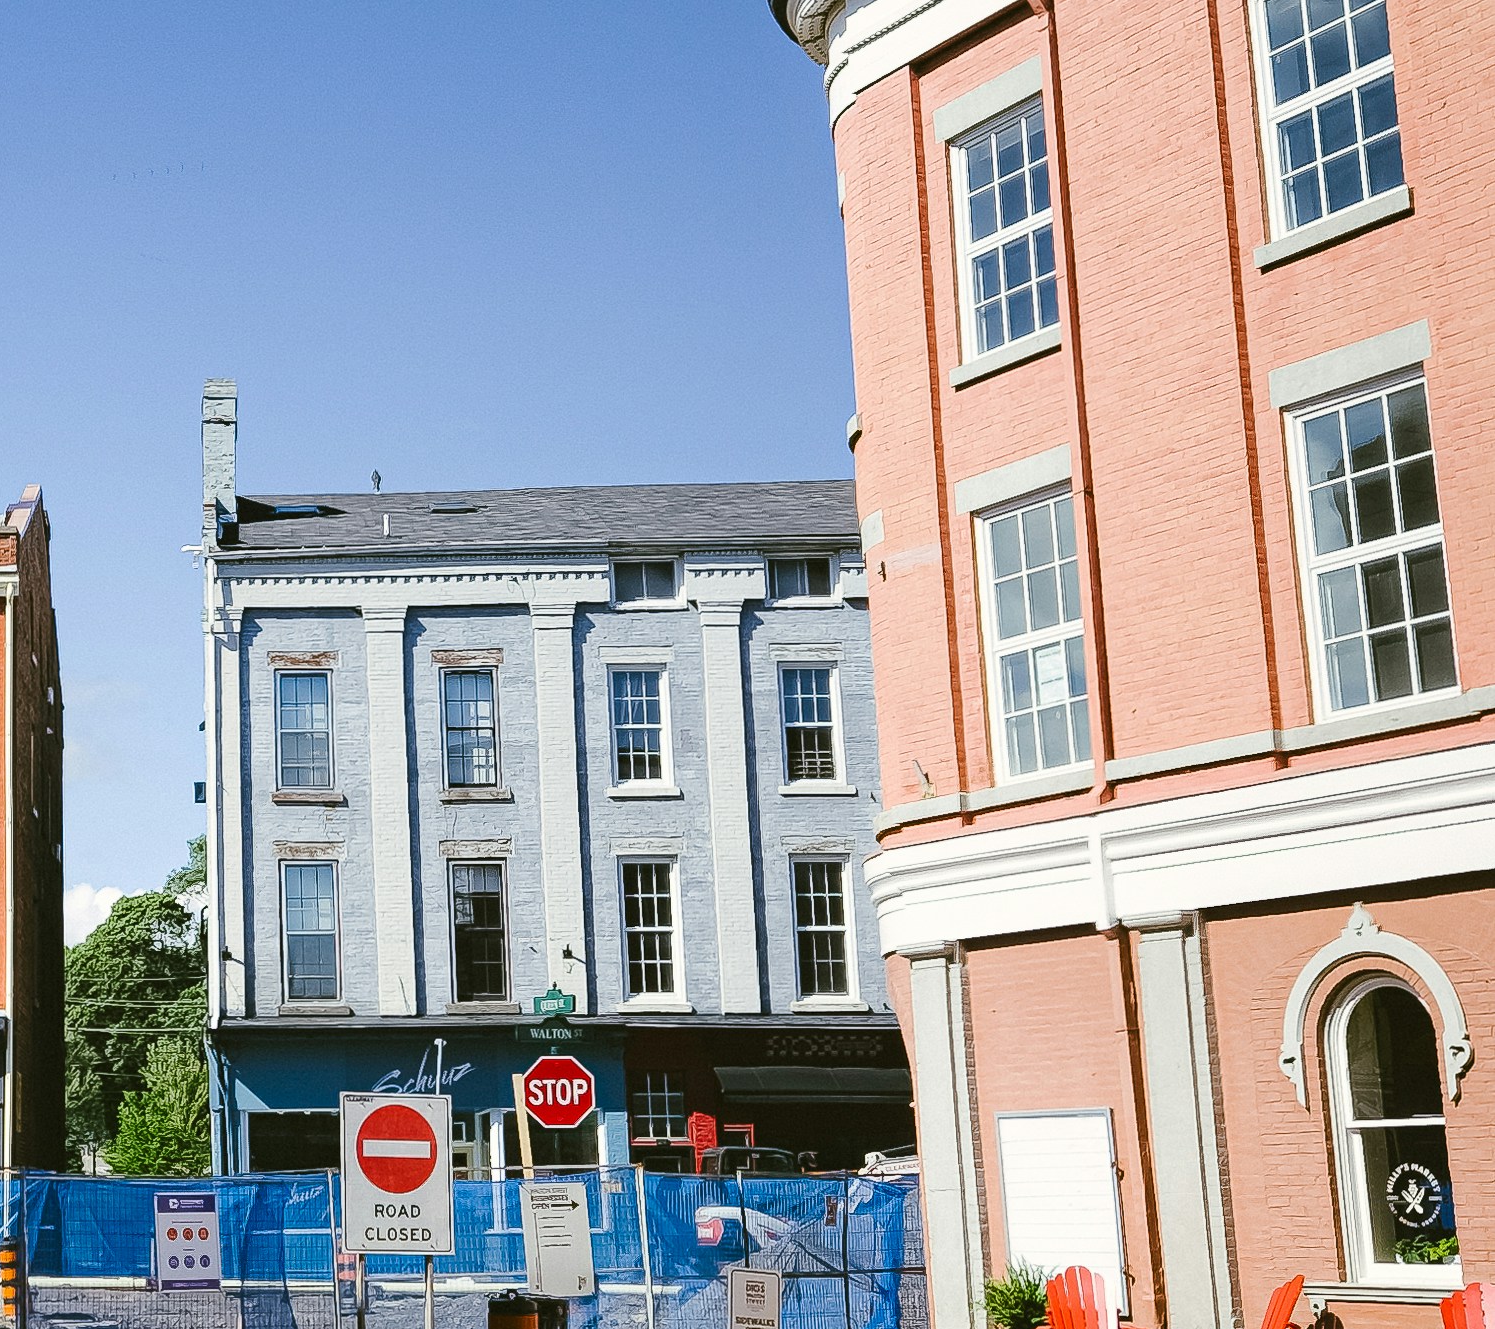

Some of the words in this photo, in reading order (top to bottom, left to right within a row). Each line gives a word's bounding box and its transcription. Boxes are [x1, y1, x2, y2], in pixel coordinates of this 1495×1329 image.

[530, 1028, 572, 1039] WALTON
[574, 1029, 583, 1037] ST
[528, 1078, 588, 1106] STOP
[1410, 1163, 1441, 1193] MARKET
[374, 1204, 421, 1218] ROAD
[365, 1227, 432, 1242] CLOSED
[735, 1316, 775, 1327] SIDEWALKS
